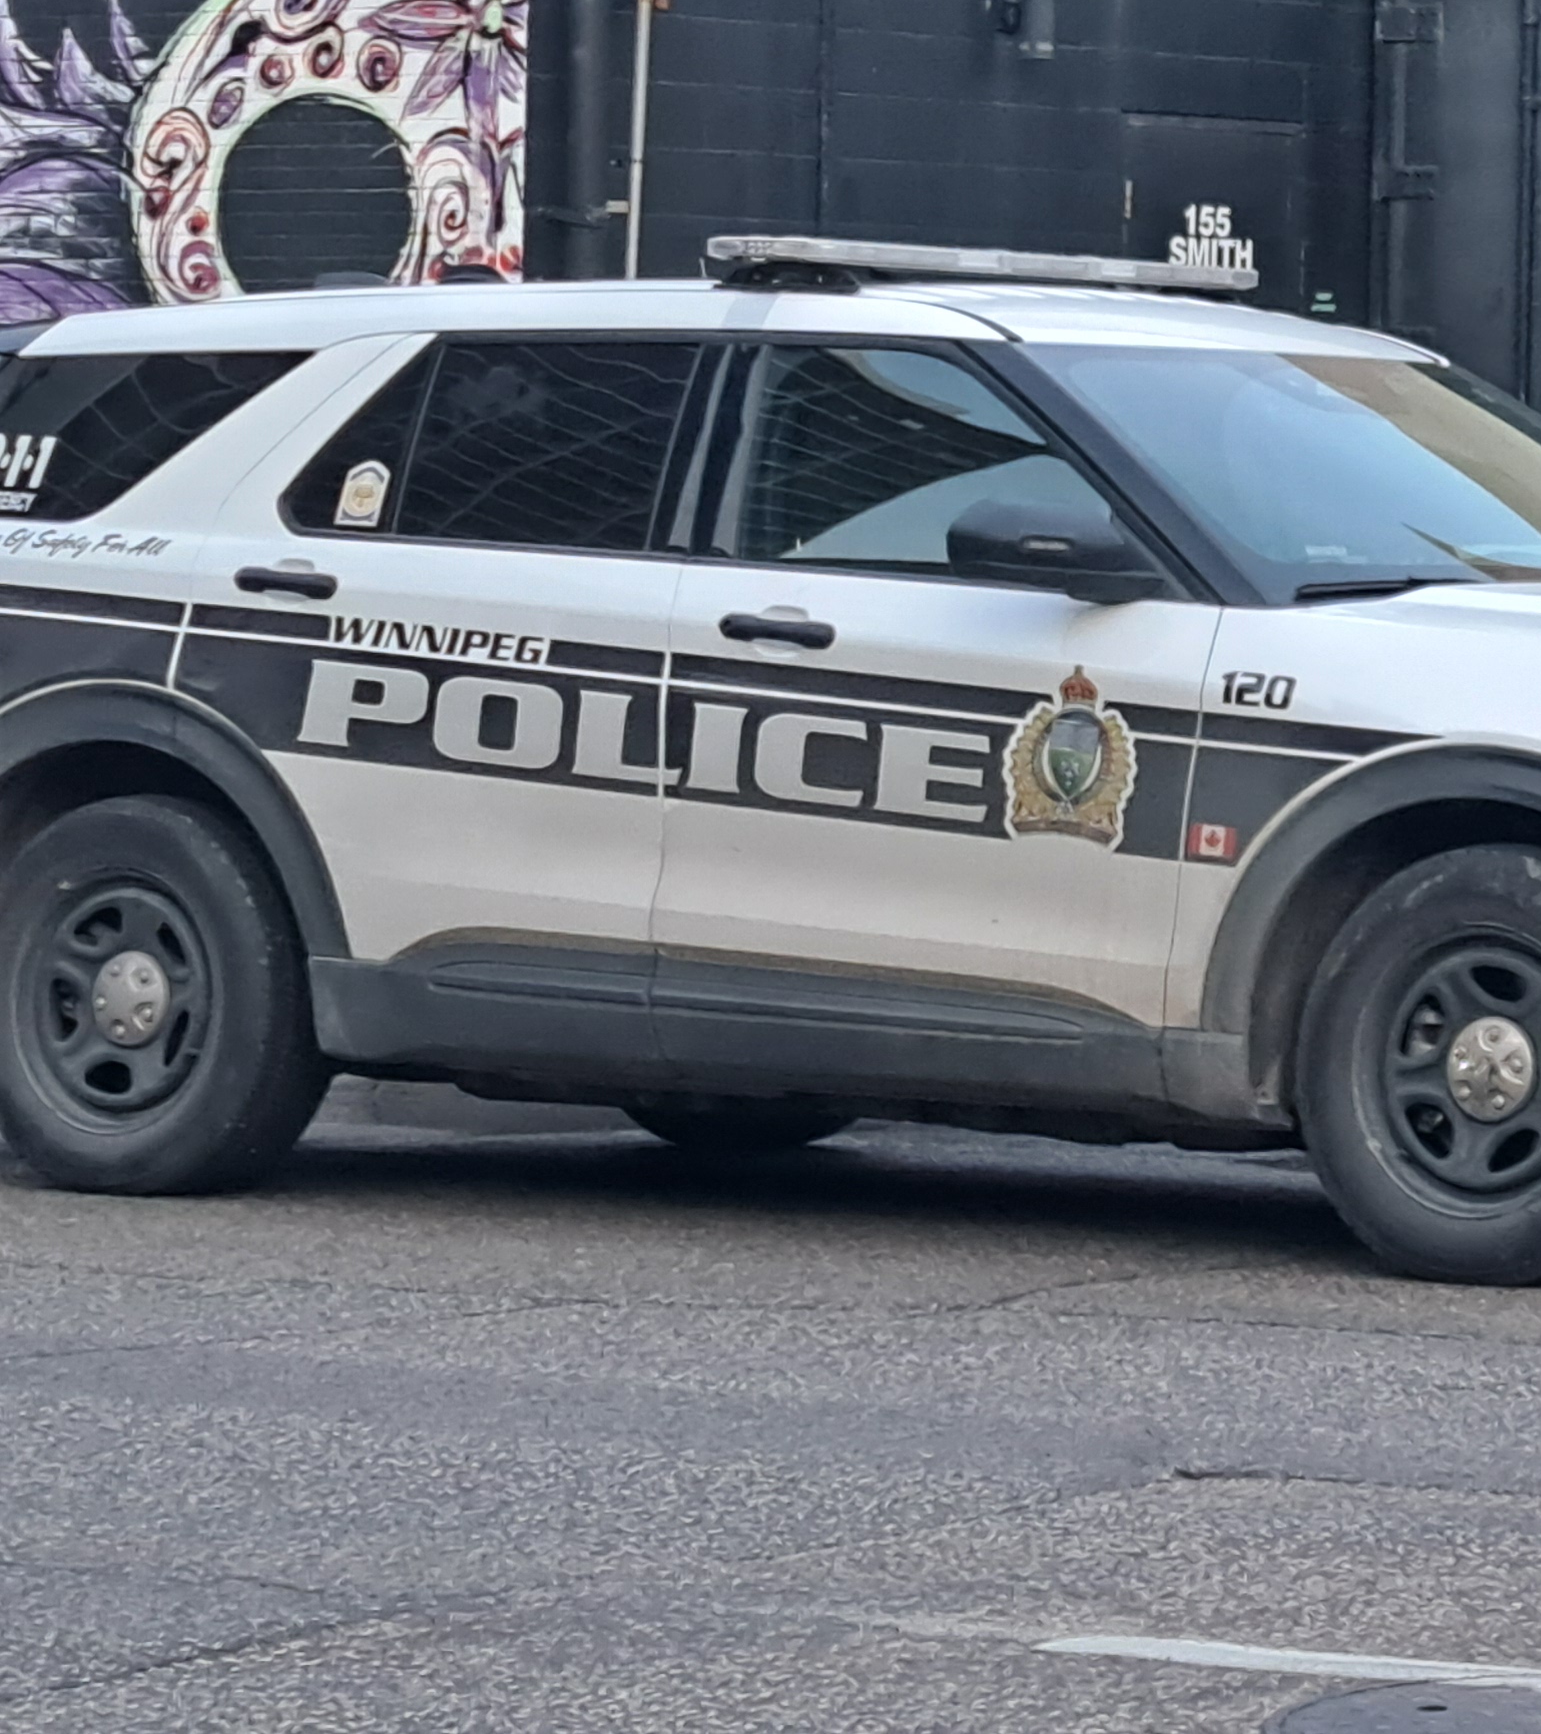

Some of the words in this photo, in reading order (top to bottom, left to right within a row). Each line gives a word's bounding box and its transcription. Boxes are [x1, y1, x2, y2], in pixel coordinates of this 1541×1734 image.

[1184, 203, 1232, 237] 155
[1168, 236, 1254, 270] SMITH
[332, 616, 545, 665] WINNIPEG
[1222, 670, 1297, 710] 120
[296, 659, 990, 822] POLICE
